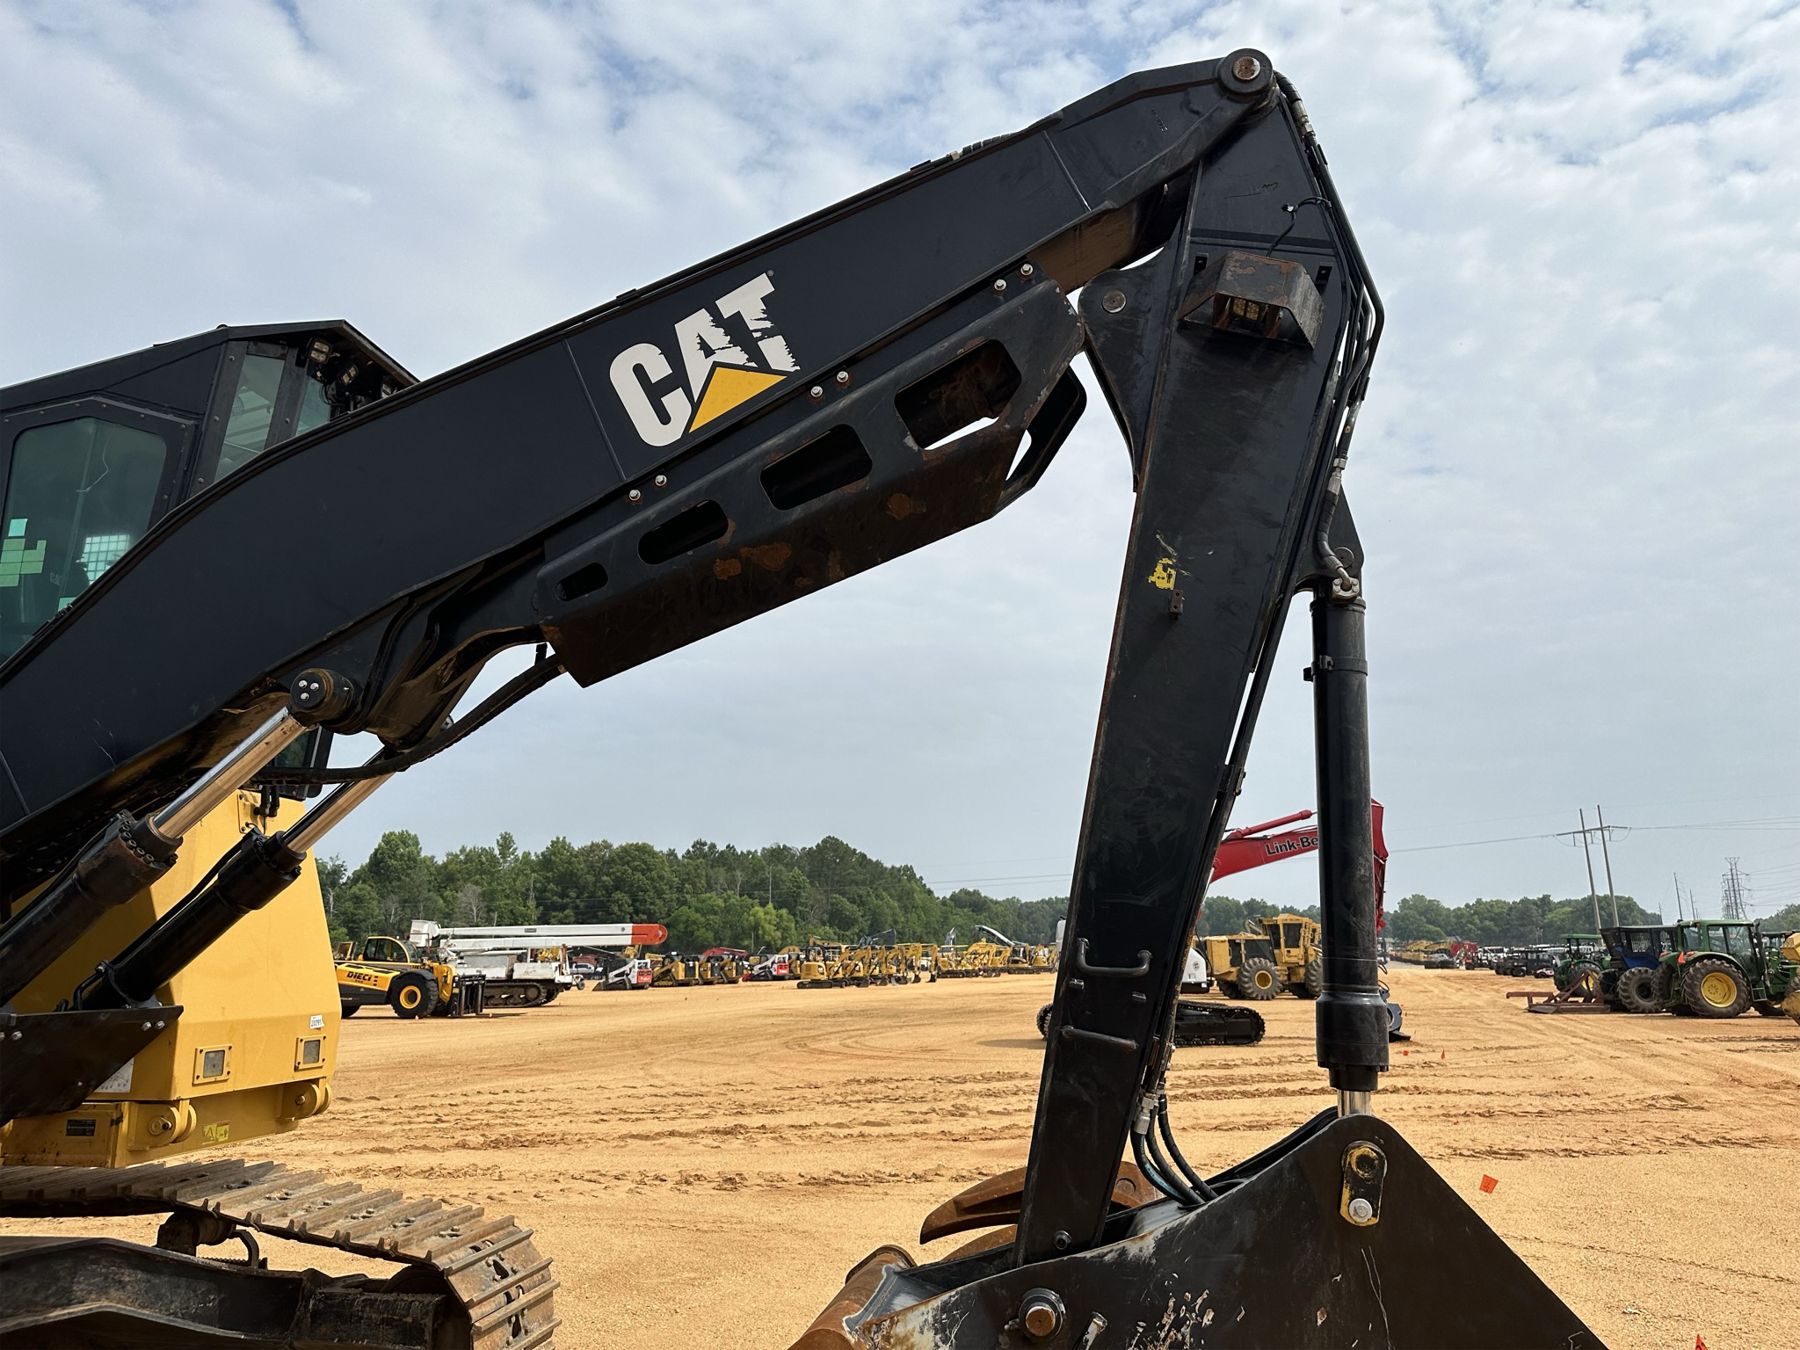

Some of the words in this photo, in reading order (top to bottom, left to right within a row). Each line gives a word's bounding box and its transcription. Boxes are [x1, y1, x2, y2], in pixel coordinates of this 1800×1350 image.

[609, 272, 800, 447] CAT
[1265, 836, 1319, 855] Link-Be
[346, 971, 372, 981] DIECI
